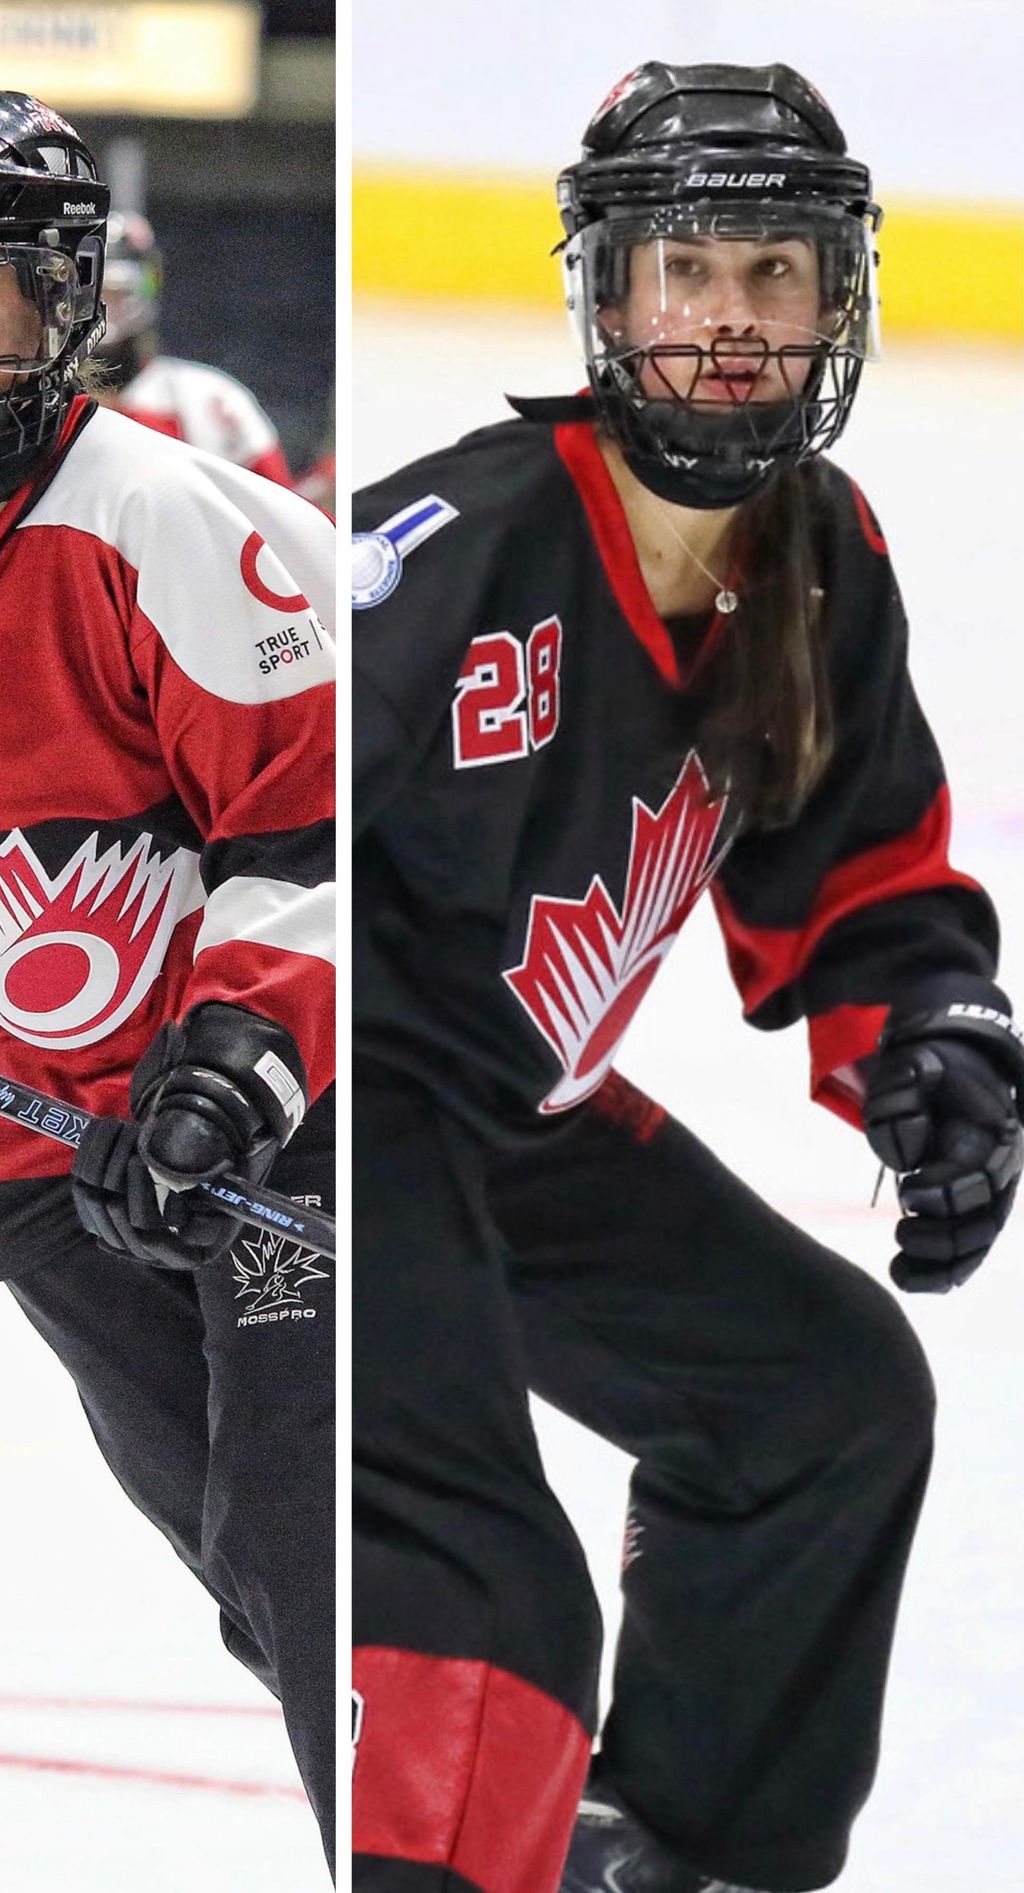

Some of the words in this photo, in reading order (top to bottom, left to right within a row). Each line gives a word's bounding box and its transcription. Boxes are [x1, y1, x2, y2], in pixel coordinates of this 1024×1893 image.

[63, 201, 96, 215] Reebok
[255, 627, 299, 656] TRUE
[259, 640, 310, 675] SPORT
[451, 614, 562, 770] 28
[237, 1308, 316, 1328] MOSSPRO
